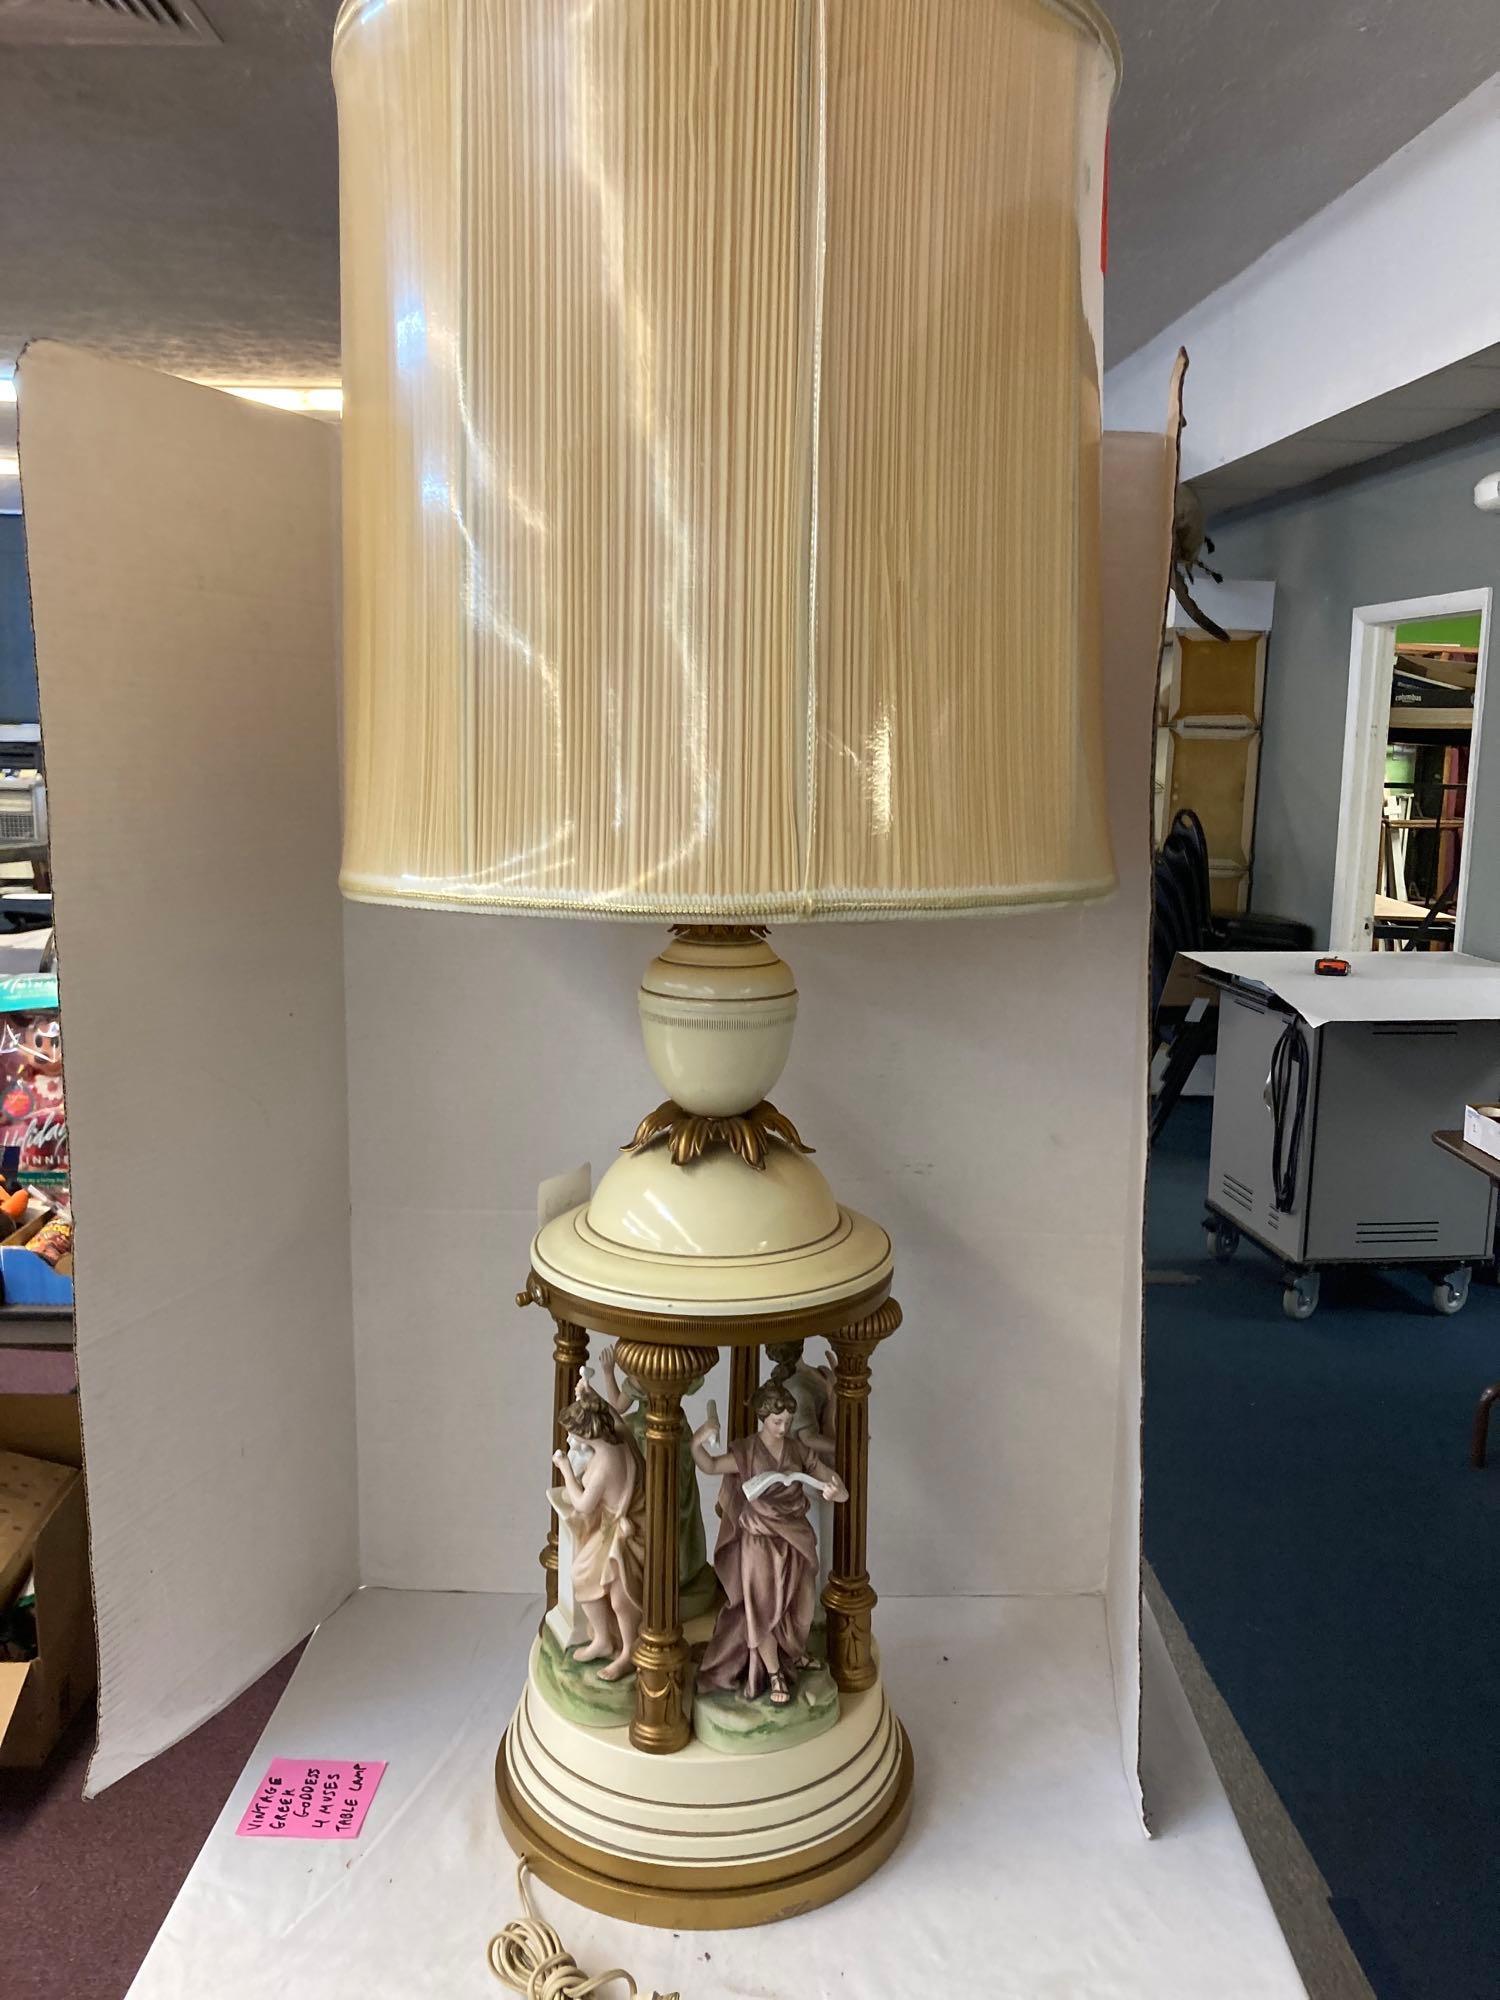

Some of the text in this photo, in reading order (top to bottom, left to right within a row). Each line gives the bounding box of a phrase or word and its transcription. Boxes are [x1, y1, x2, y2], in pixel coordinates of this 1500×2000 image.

[246, 1776, 282, 1830] VINTAGE
[269, 1788, 295, 1829] GREEK
[312, 1773, 340, 1828] 4 MUSES
[336, 1763, 367, 1832] TABLE LAMP
